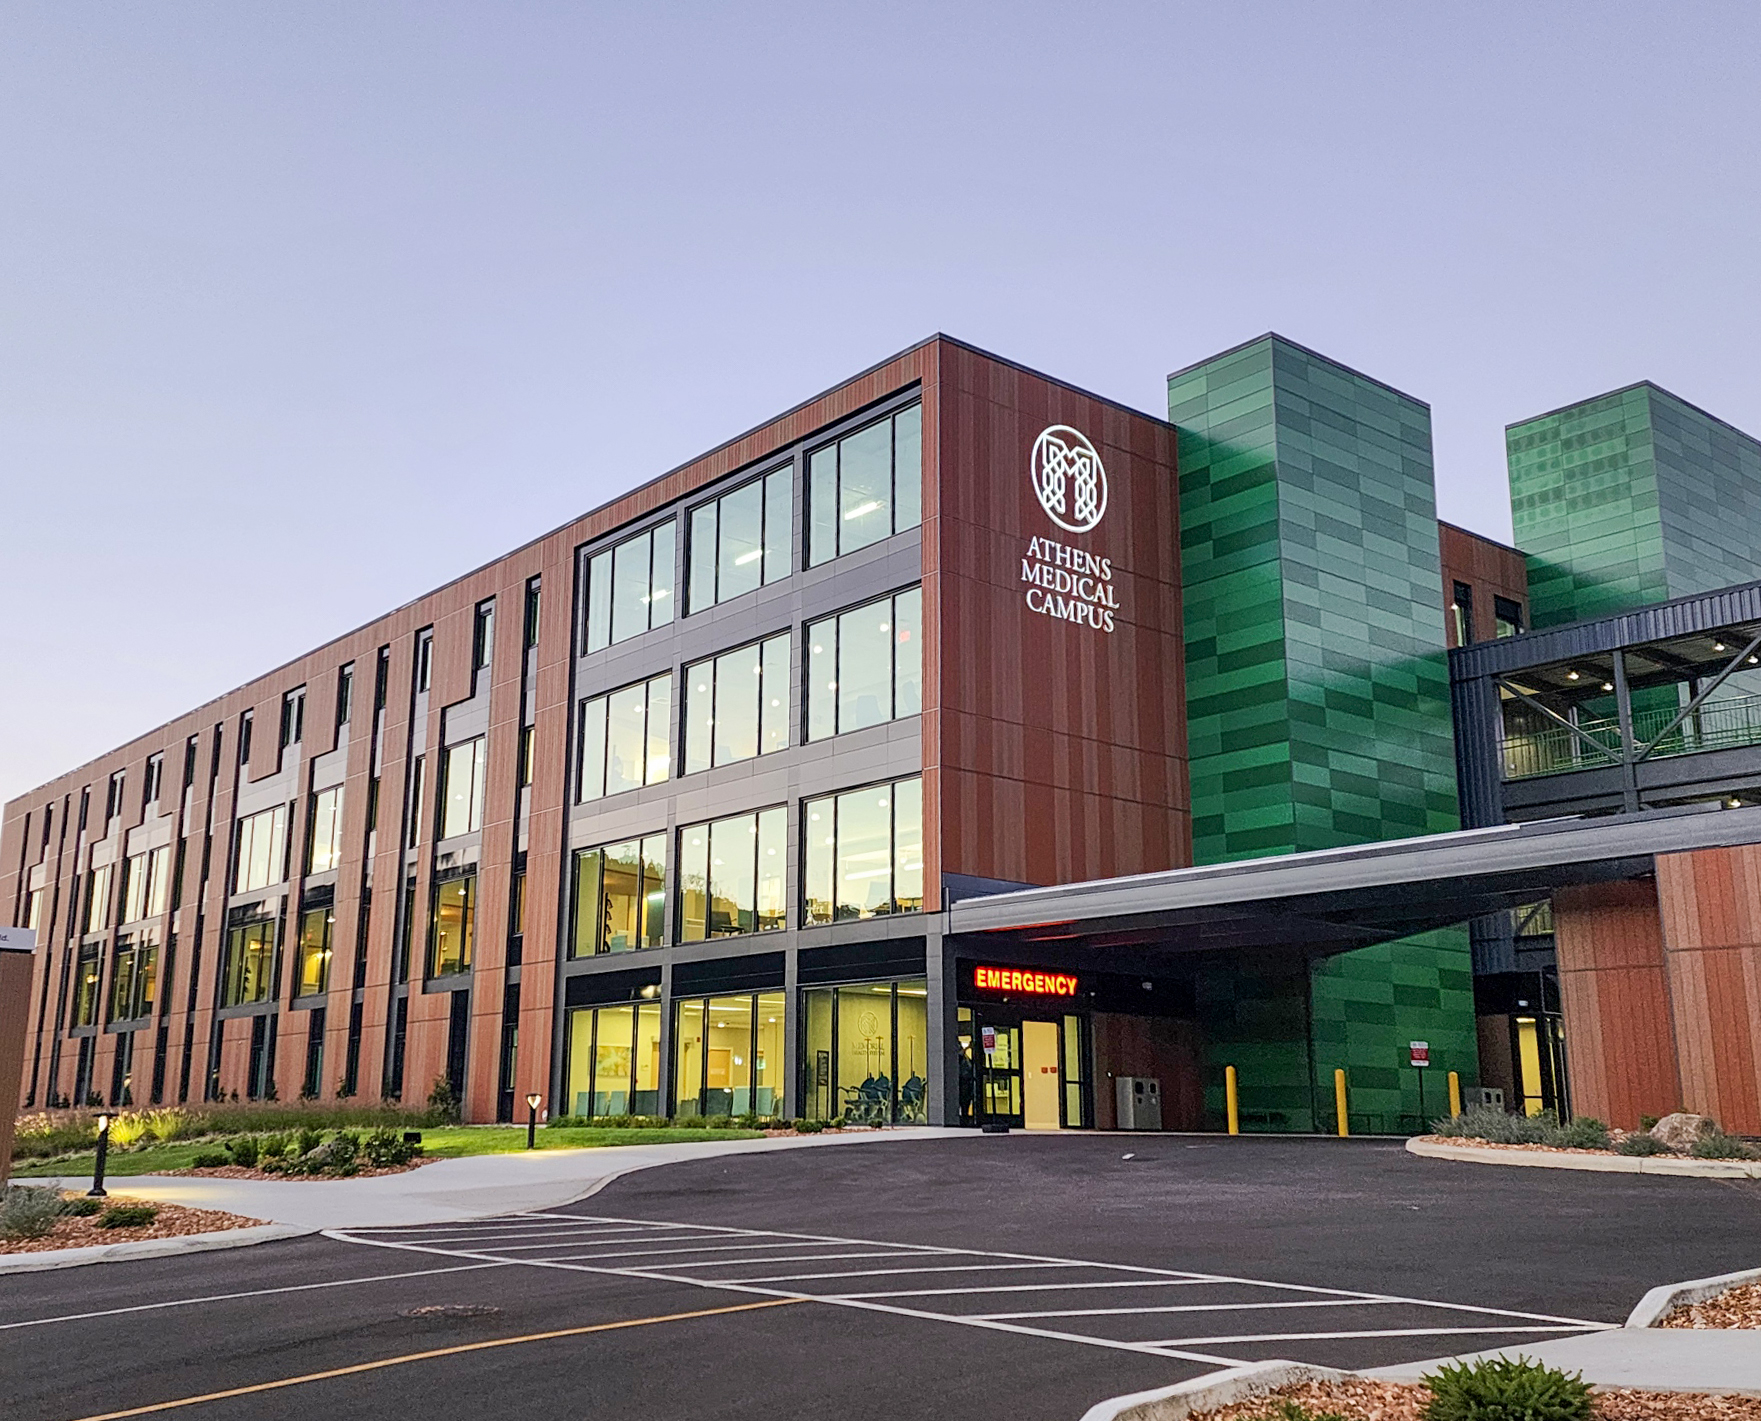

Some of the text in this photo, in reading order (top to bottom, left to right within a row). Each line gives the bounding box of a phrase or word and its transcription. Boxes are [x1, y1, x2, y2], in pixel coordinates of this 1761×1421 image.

[1026, 535, 1112, 581] ATHENS
[1021, 558, 1120, 609] MEDICAL
[1026, 588, 1115, 633] CAMPUS
[975, 967, 1077, 995] EMERGENCY
